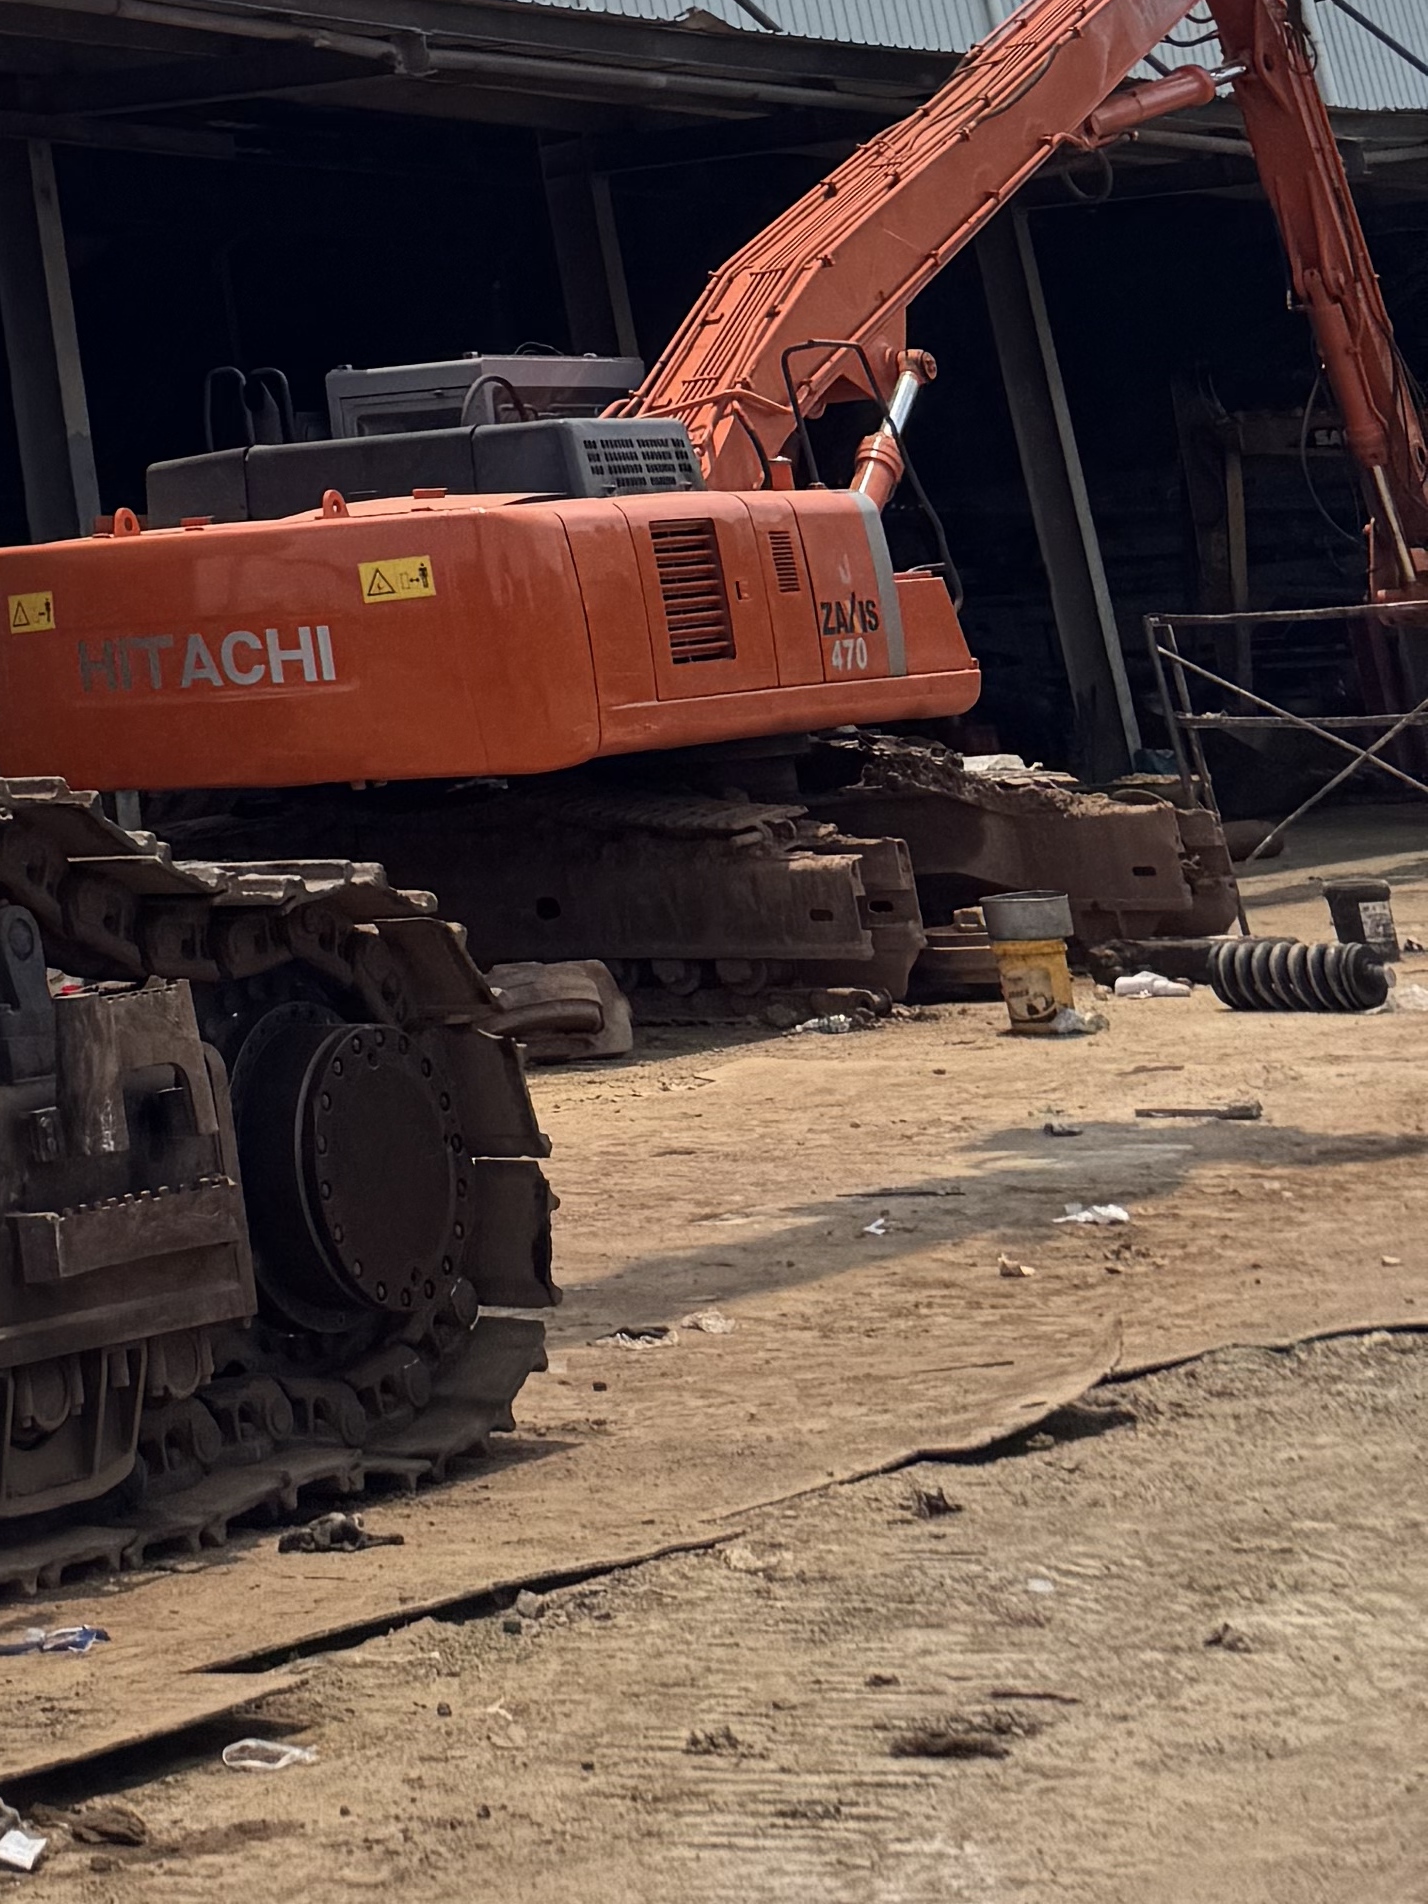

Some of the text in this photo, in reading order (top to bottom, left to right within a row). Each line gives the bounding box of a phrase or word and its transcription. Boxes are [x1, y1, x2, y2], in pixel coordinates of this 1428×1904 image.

[820, 591, 879, 636] ZAXIS
[78, 625, 337, 692] HITACHI
[831, 637, 868, 672] 470
